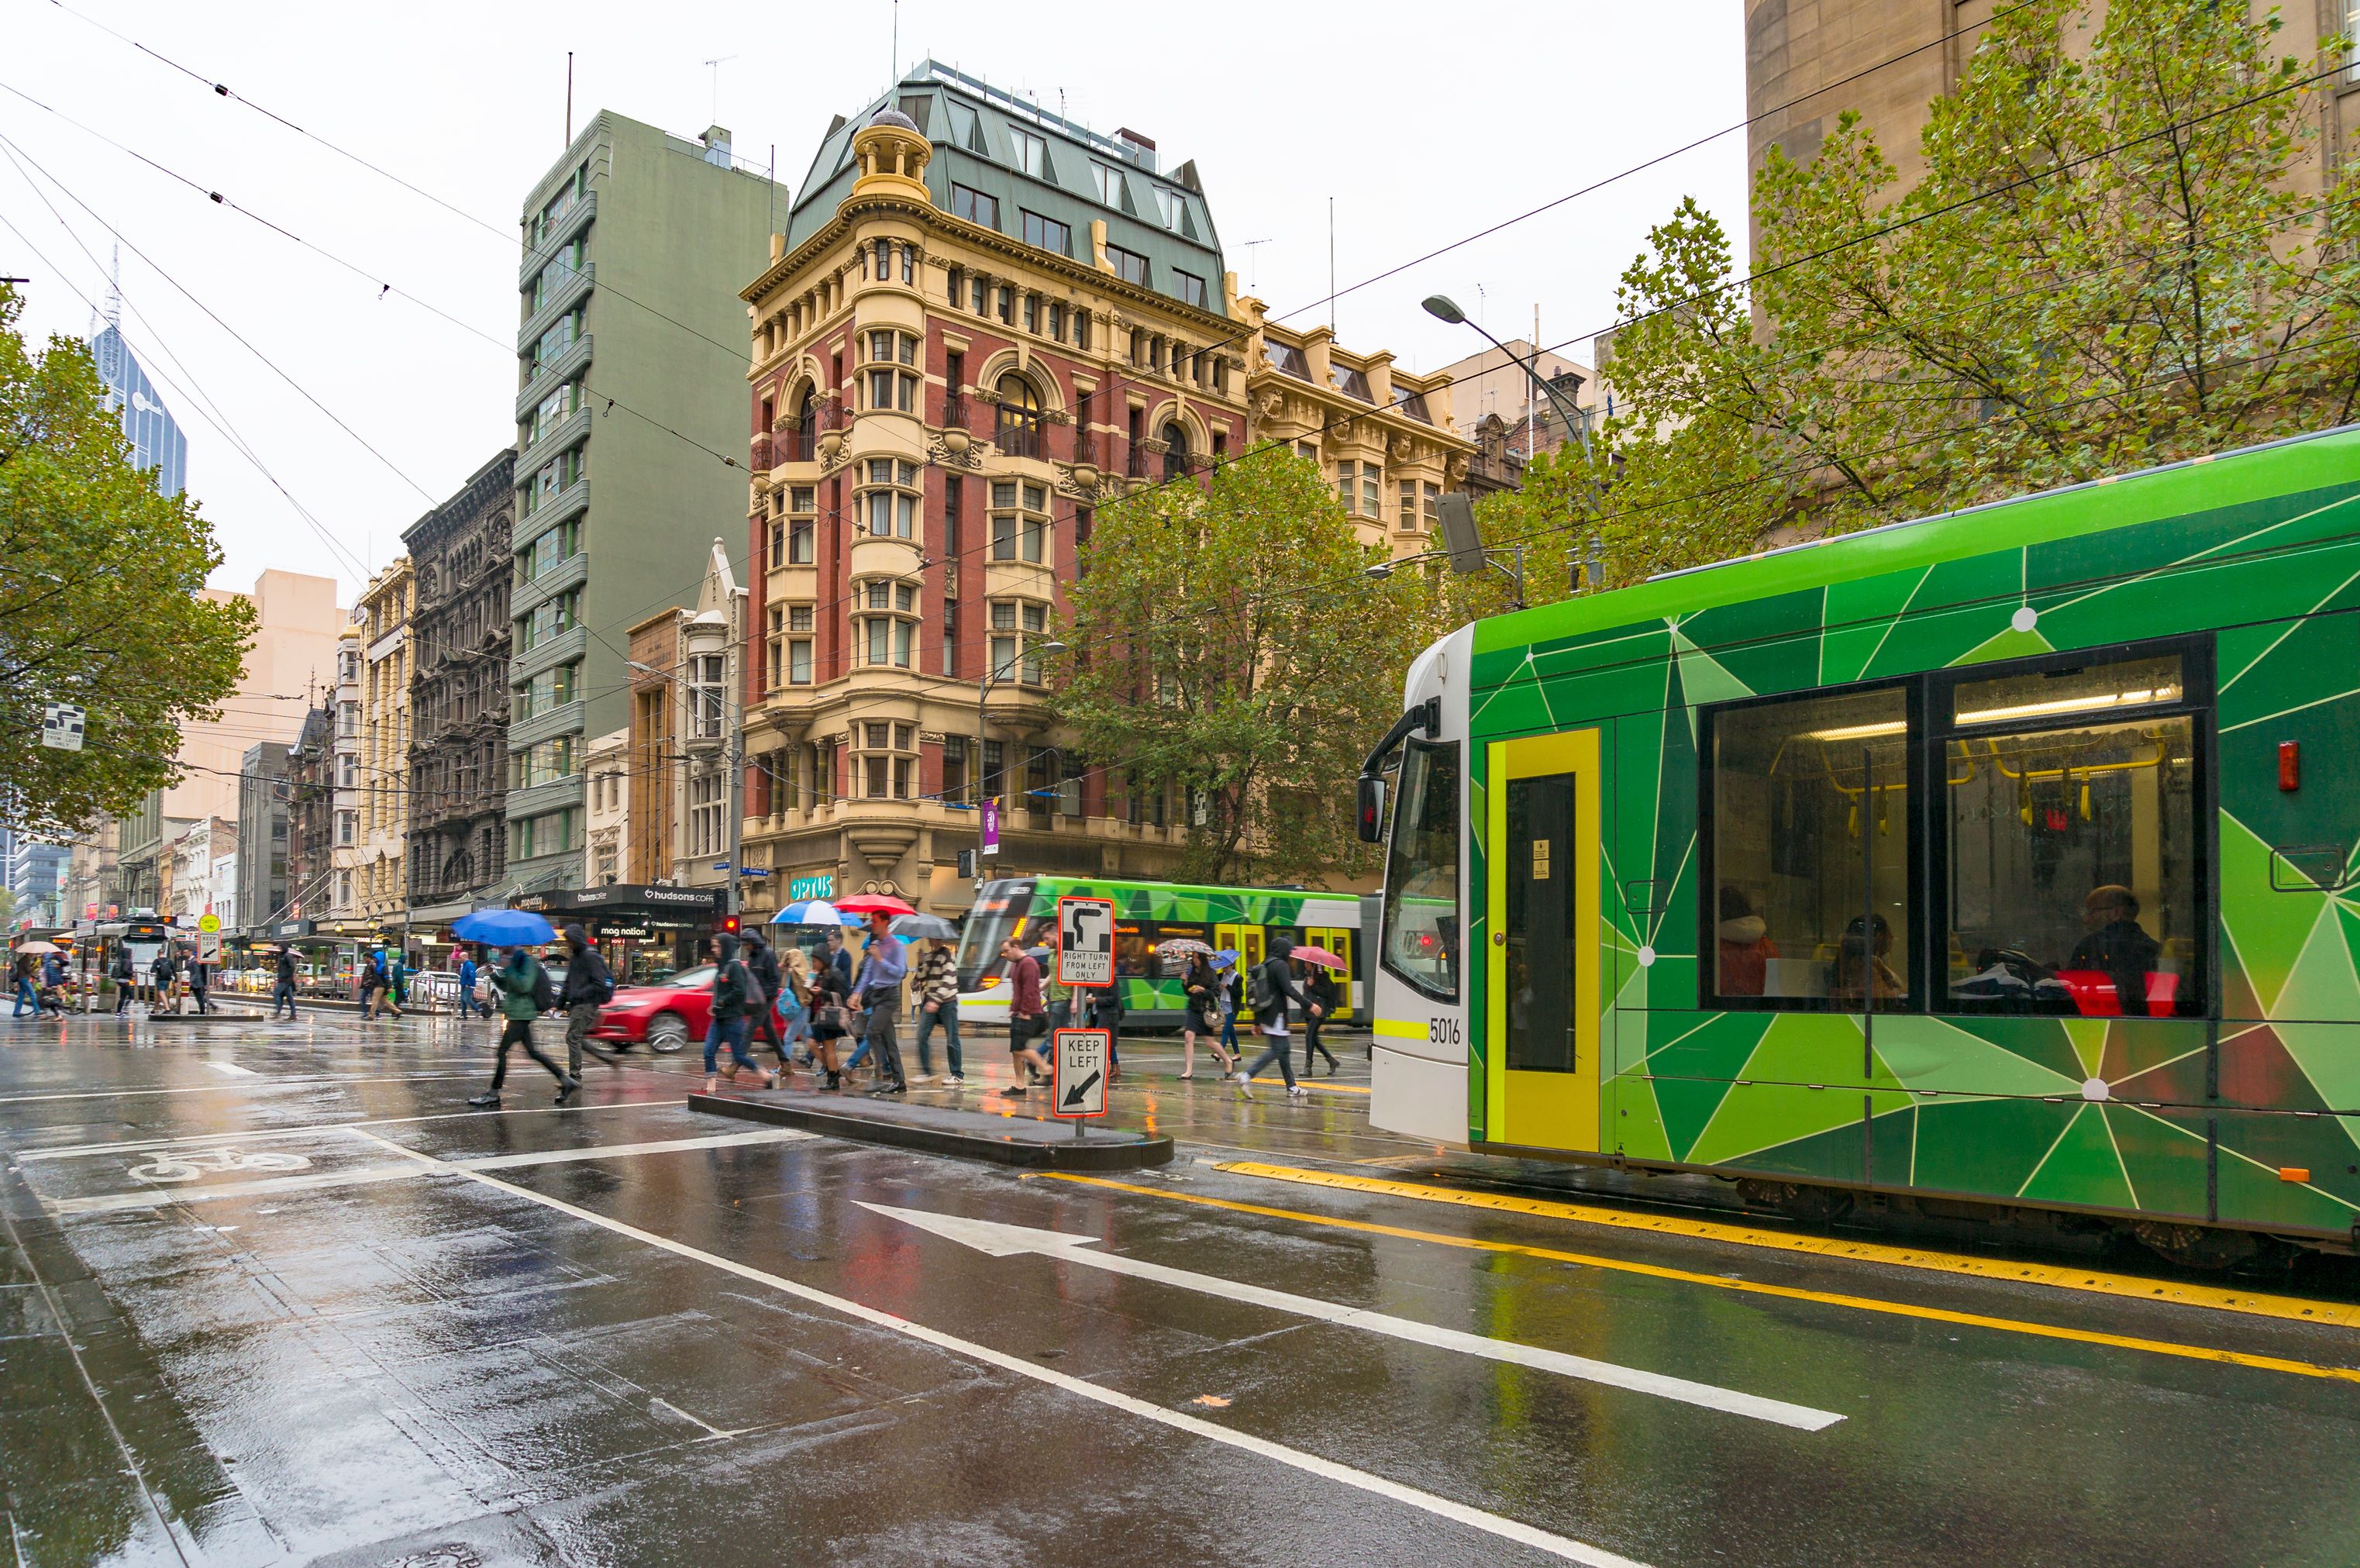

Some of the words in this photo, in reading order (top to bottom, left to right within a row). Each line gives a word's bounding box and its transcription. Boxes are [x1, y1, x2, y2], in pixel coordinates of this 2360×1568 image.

[753, 847, 765, 867] 82
[791, 875, 833, 900] OPTUS
[654, 891, 695, 901] hudsons
[695, 894, 714, 902] coff
[601, 928, 619, 937] mag
[621, 926, 646, 936] nation
[1430, 1018, 1460, 1045] 5016
[1068, 1040, 1100, 1052] KEEP
[1070, 1056, 1098, 1068] LEFT
